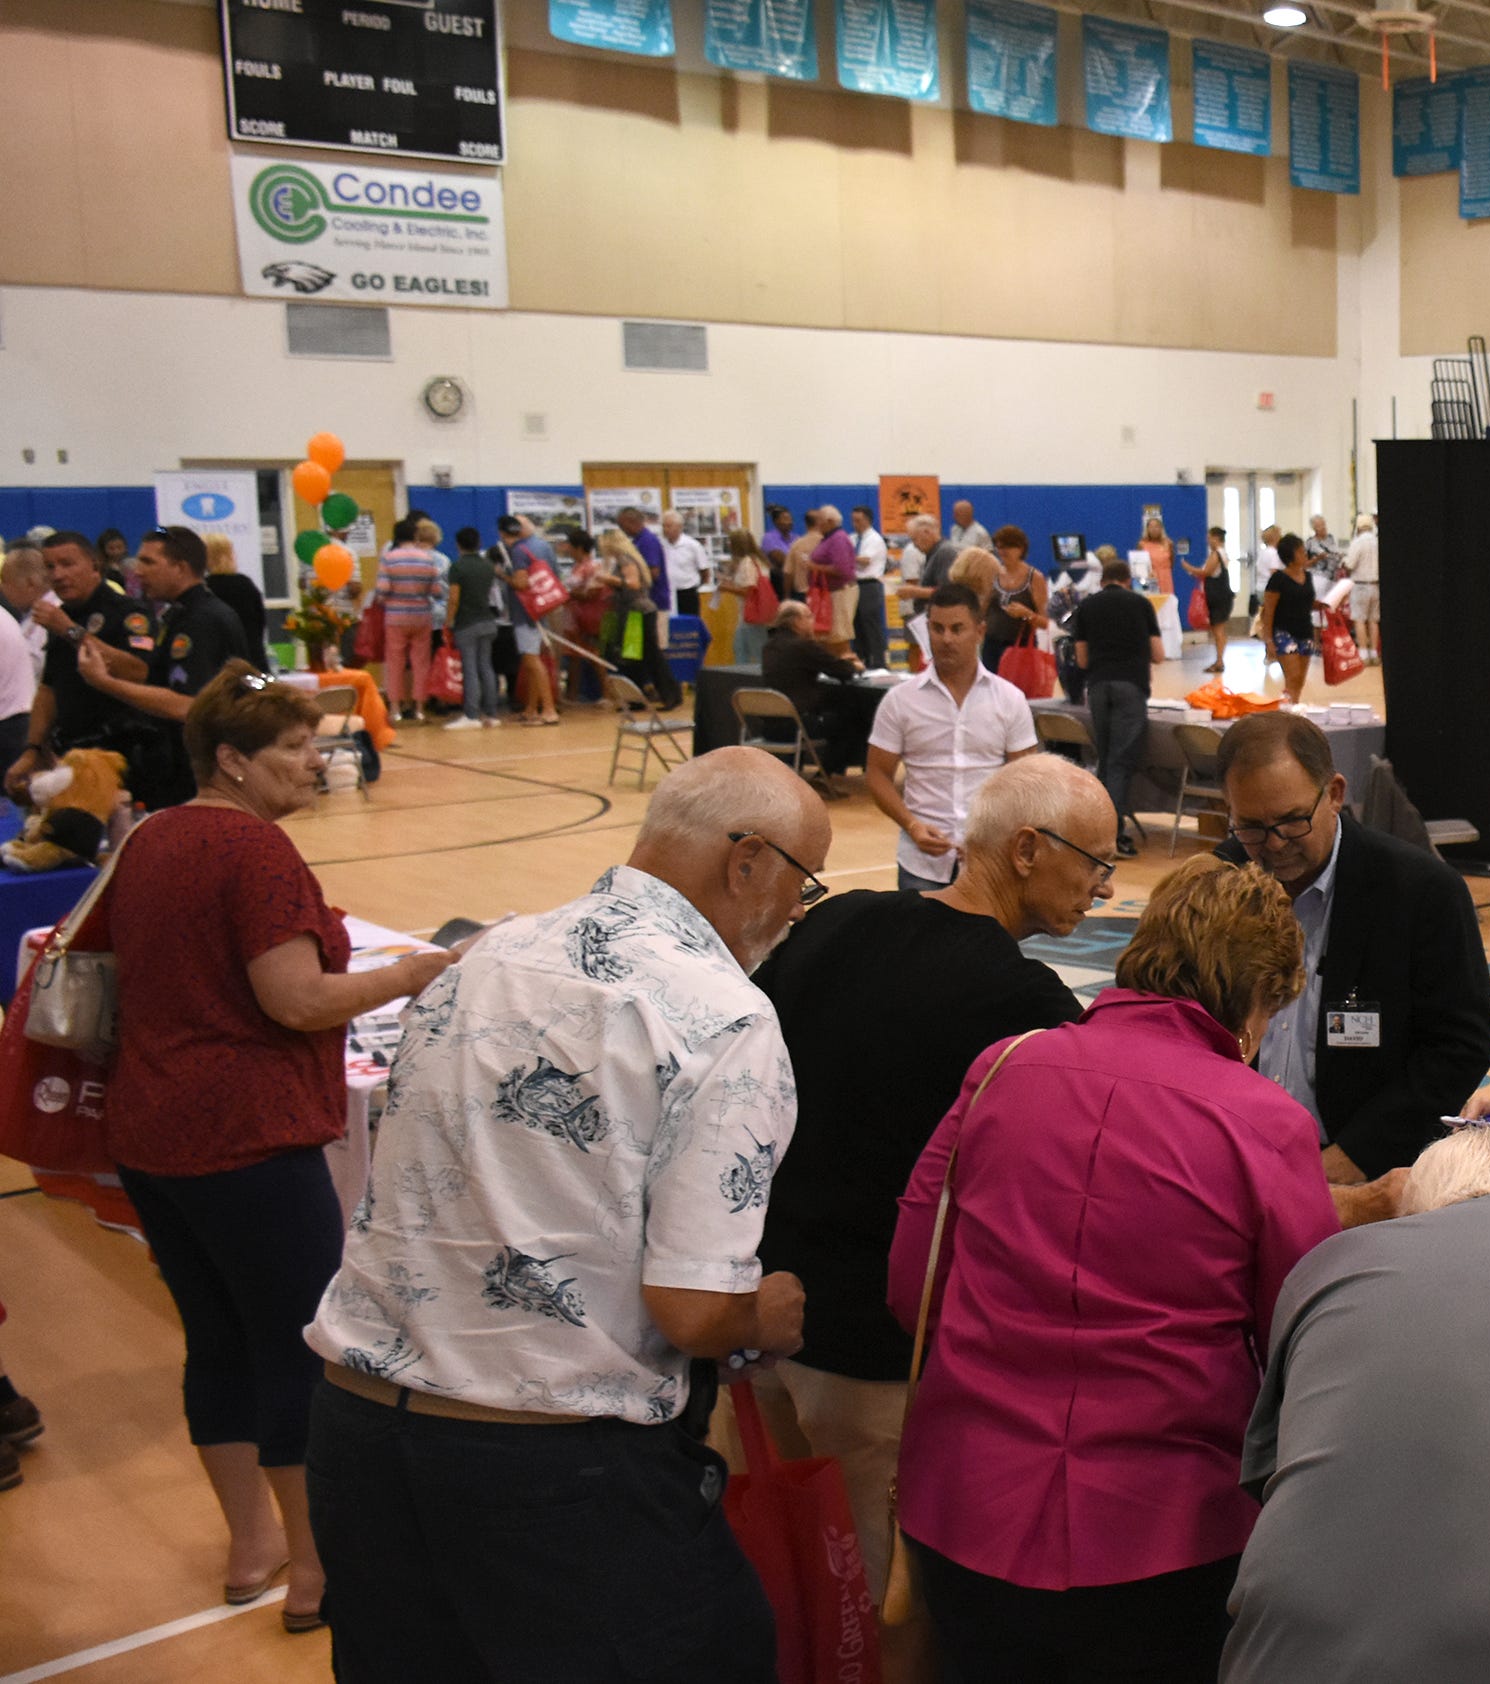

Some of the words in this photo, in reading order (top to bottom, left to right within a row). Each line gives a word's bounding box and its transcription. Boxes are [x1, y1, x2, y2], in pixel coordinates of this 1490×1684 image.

[341, 10, 392, 31] PERIOD
[423, 11, 485, 38] GUEST
[235, 59, 282, 81] FOULS
[323, 70, 375, 91] PLAYER
[382, 76, 418, 97] FOUL
[454, 85, 497, 106] FOULS
[239, 118, 286, 138] SCORE
[349, 129, 399, 149] MATCH
[458, 141, 500, 159] SCORE
[332, 172, 482, 213] Condee
[351, 273, 386, 291] GO
[394, 274, 490, 297] EAGLES!
